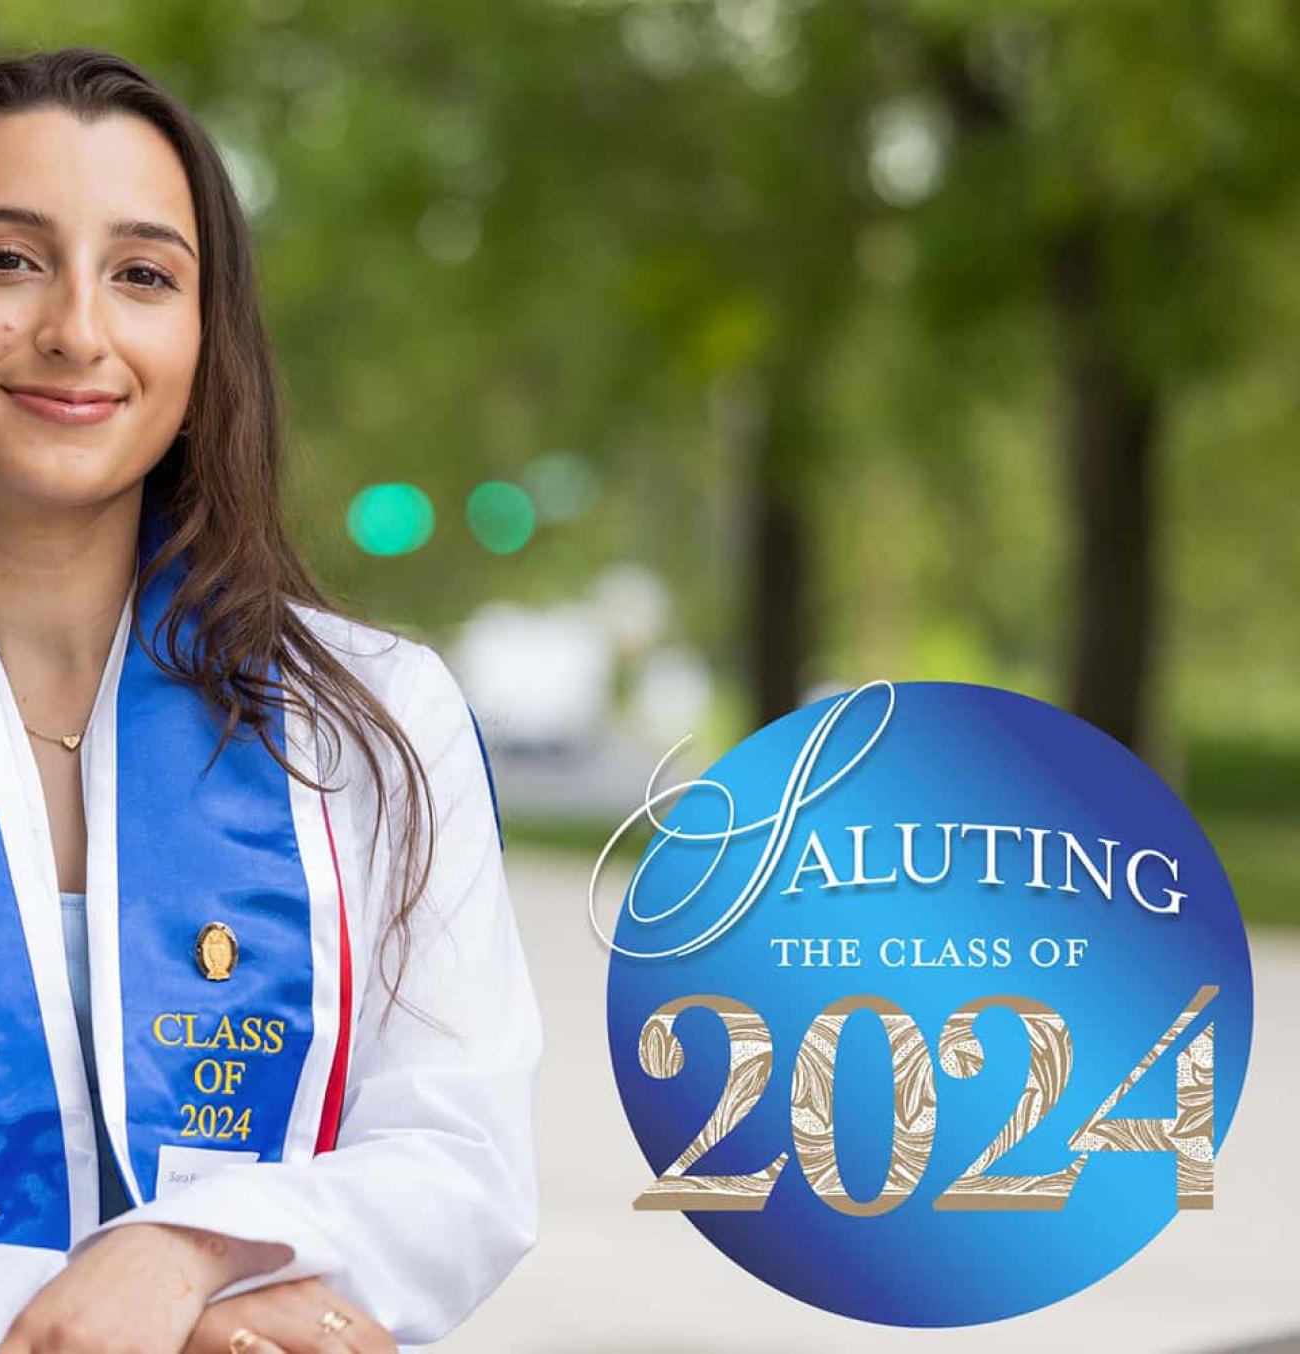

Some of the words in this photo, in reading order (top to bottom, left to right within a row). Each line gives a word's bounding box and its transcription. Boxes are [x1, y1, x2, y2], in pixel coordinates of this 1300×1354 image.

[153, 1013, 285, 1054] CLASS
[194, 1059, 246, 1095] OF
[180, 1104, 252, 1141] 2024
